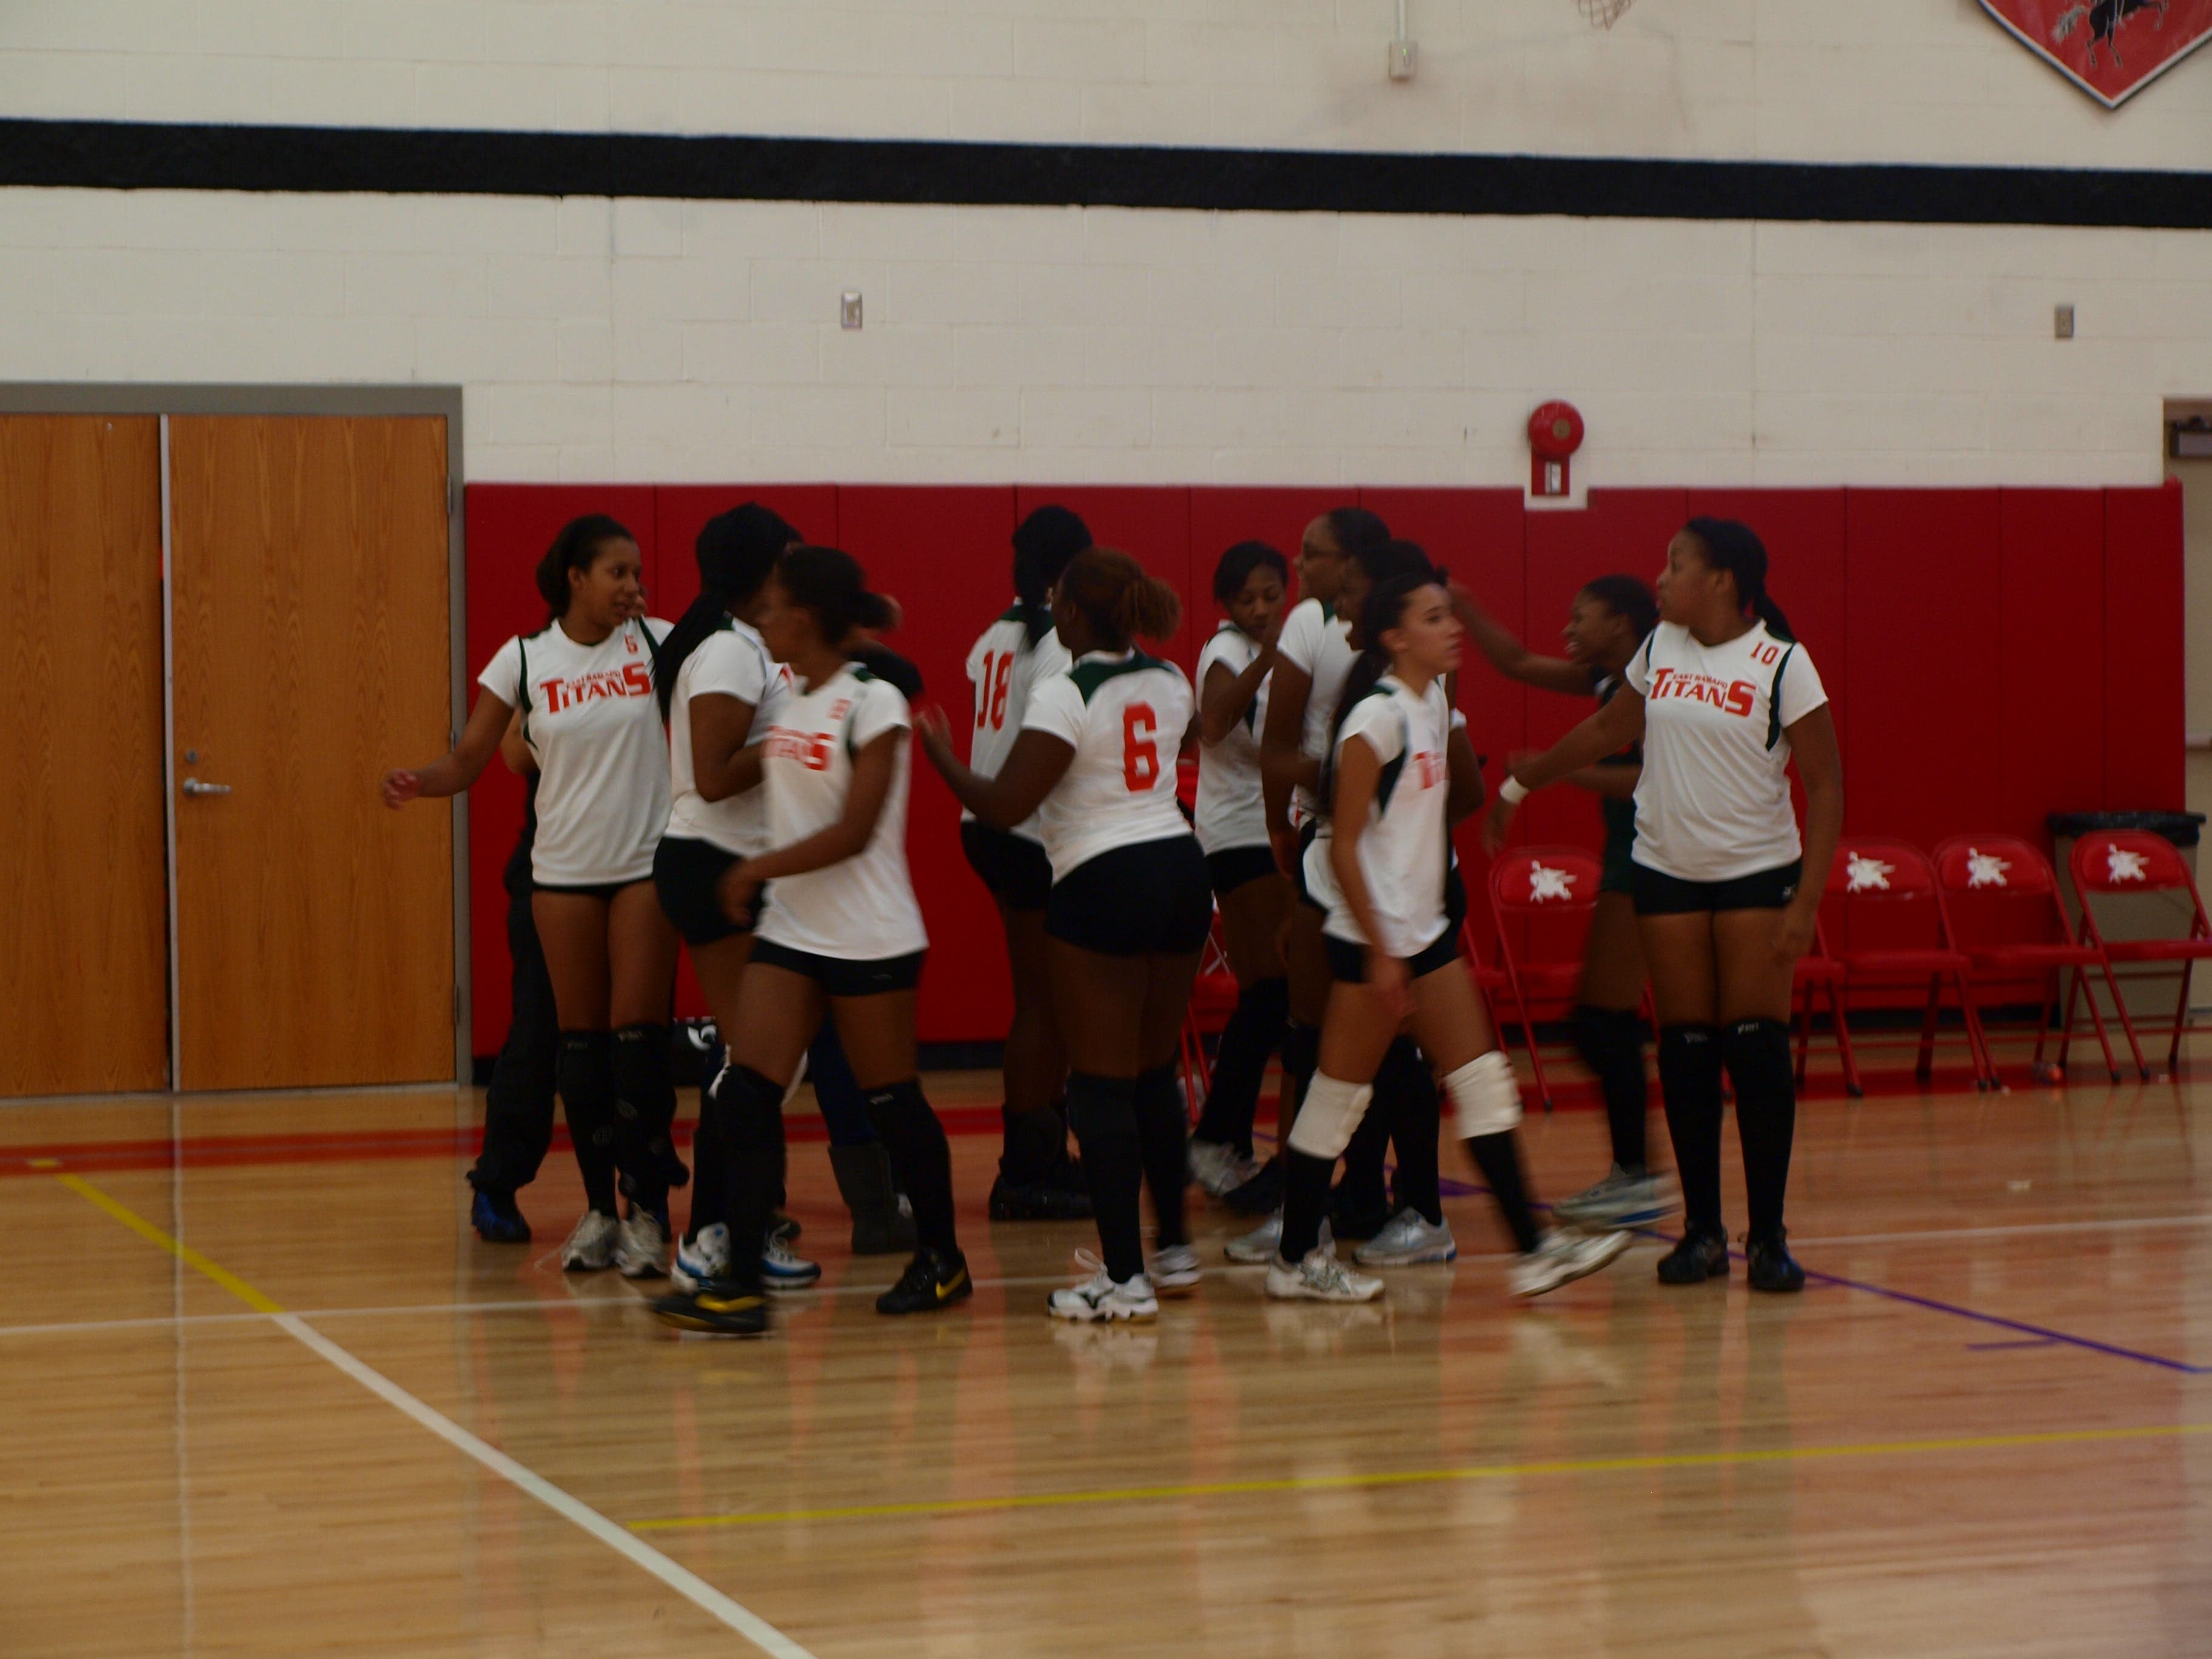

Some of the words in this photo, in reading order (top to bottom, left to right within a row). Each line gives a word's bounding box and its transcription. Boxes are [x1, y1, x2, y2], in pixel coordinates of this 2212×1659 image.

[1751, 641, 1779, 665] 10
[540, 660, 651, 714] TITANS
[977, 649, 1015, 731] 18
[1651, 668, 1756, 717] TITANS
[1124, 701, 1159, 791] 6
